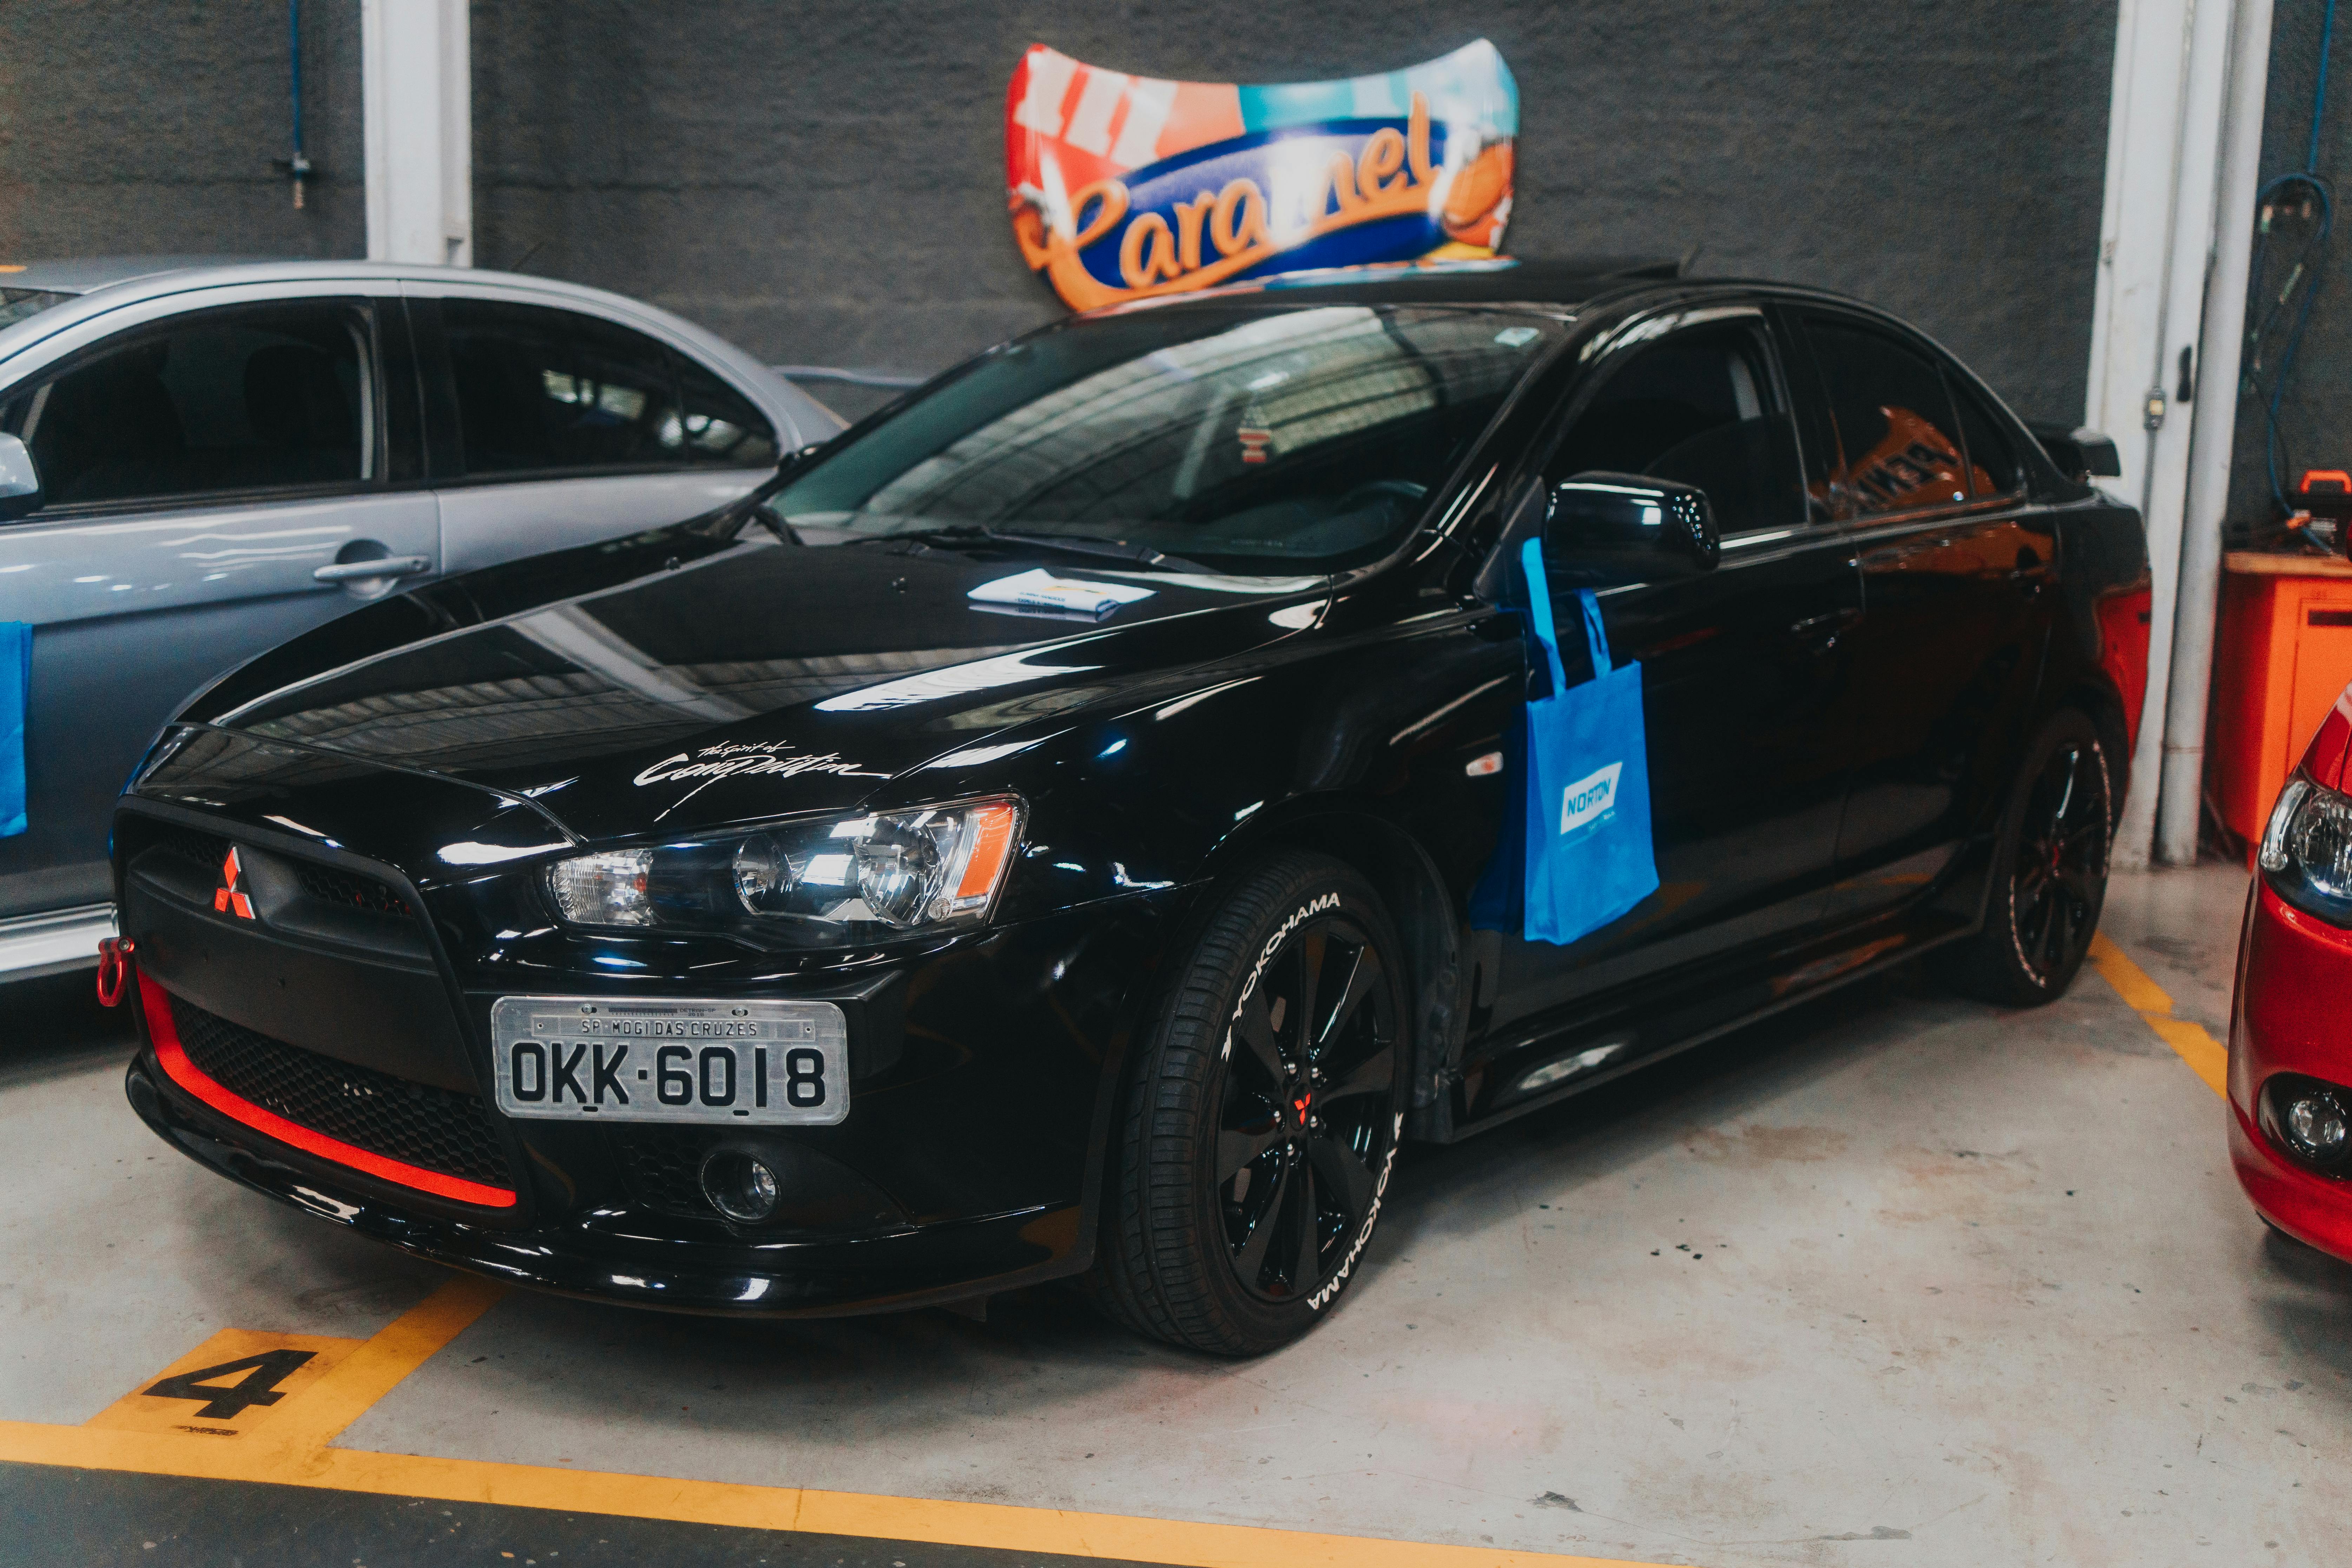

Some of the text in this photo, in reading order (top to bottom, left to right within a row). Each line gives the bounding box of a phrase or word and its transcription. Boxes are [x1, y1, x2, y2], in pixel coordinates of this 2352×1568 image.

[763, 740, 796, 753] of
[1232, 892, 1340, 1021] YOKOHAMA
[613, 1021, 649, 1035] MOGI
[655, 1021, 685, 1036] DAS
[691, 1022, 757, 1036] CRUZES
[1307, 1147, 1397, 1310] YOKOHAMA
[140, 1349, 319, 1420] 4
